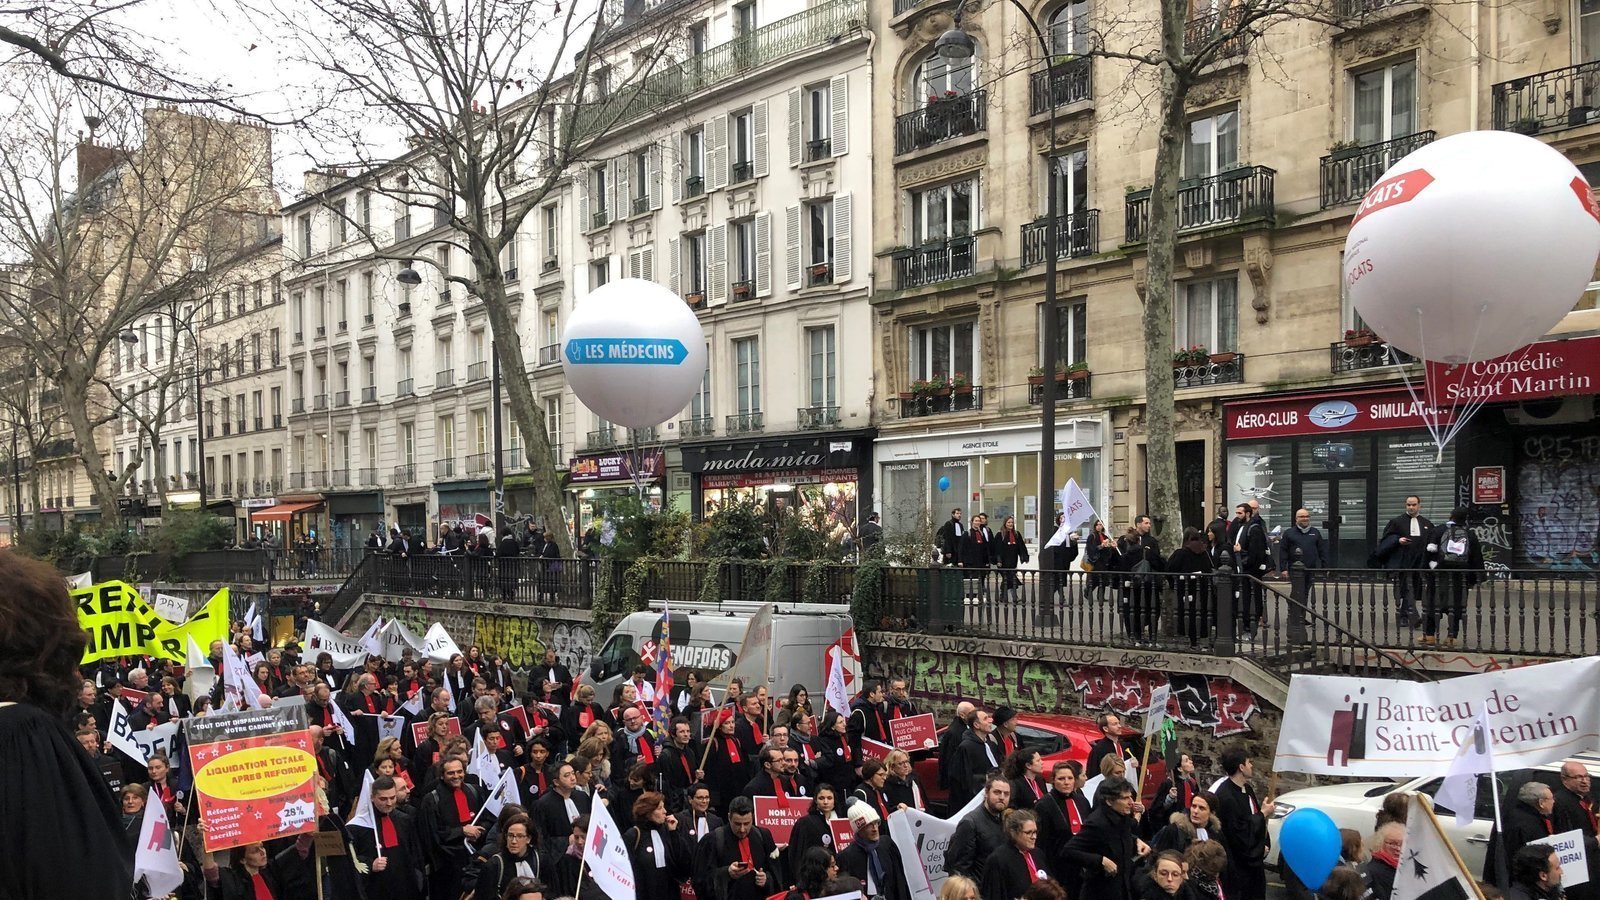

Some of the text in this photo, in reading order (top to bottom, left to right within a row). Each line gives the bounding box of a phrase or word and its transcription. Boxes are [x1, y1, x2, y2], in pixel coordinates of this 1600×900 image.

[586, 340, 674, 359] LES MÉDECINS
[1472, 352, 1564, 376] Comédie
[1447, 372, 1591, 399] Saint Martin
[1370, 401, 1447, 419] SIMULAT
[1236, 411, 1298, 429] AÉRO-CLUB
[599, 457, 622, 466] LUCKY
[1076, 452, 1100, 460] YNDIC
[885, 463, 919, 471] TRANSACTION
[159, 597, 184, 611] DAX
[388, 633, 406, 646] DE
[662, 643, 731, 671] ENOFORS
[1376, 689, 1521, 723] Barreau de
[215, 720, 231, 728] DOIT
[225, 726, 247, 734] VOTRE
[248, 722, 276, 731] CABINET
[277, 719, 295, 728] AVEC
[894, 720, 914, 729] RETRAITE
[906, 725, 922, 734] CHÈRE
[896, 734, 912, 742] JUSTICE
[897, 740, 917, 748] PRÉCAIRE
[206, 755, 304, 776] LIQUIDATION TOTALE
[231, 765, 308, 784] APRES REFORME
[206, 806, 239, 816] Réforme
[283, 805, 305, 818] 28%
[768, 809, 786, 817] NON
[788, 808, 792, 816] À
[209, 822, 239, 832] Avocats
[764, 818, 779, 826] TAXE
[210, 830, 242, 840] sacrifiés
[1553, 840, 1574, 853] REAU
[927, 852, 941, 862] des
